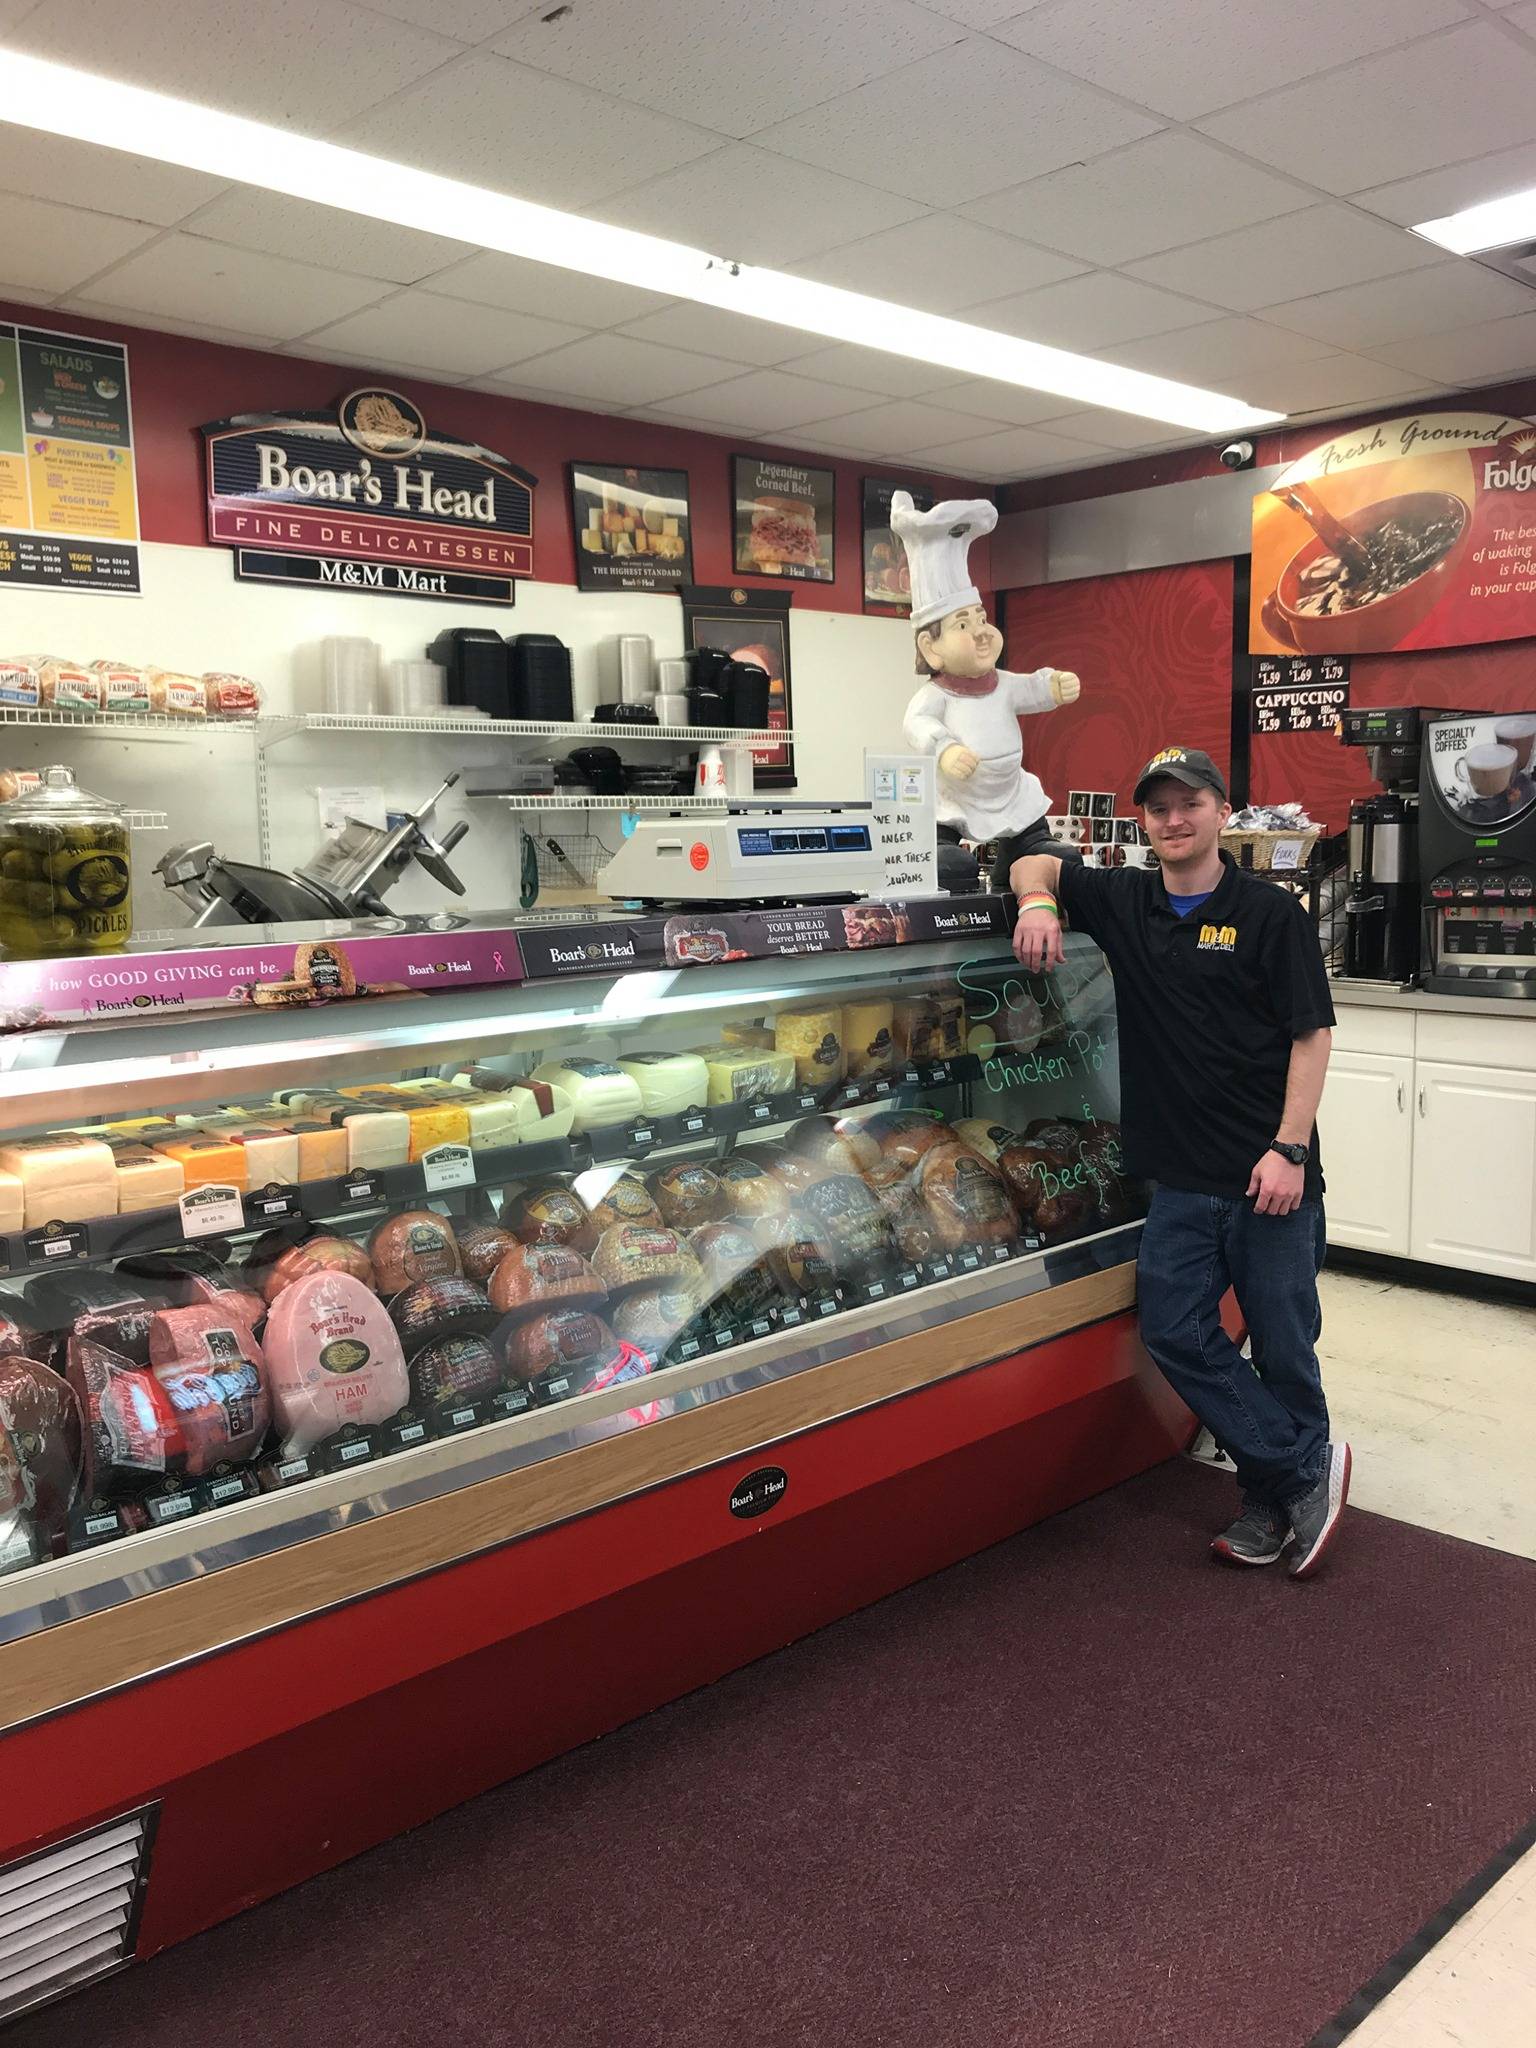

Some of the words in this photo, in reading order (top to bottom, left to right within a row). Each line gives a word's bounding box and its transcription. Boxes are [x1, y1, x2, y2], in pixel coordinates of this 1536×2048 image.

[40, 352, 93, 372] SALADS
[56, 448, 80, 457] PARTY
[82, 451, 104, 461] TRAYS
[1320, 428, 1387, 475] Fresh
[1400, 420, 1508, 455] Ground
[760, 462, 808, 482] Legendary
[256, 443, 382, 506] Boar's
[394, 465, 497, 523] Head
[755, 476, 790, 492] Corned
[791, 482, 815, 497] Beef.
[58, 495, 85, 505] VEGGIE
[87, 498, 109, 507] TRAYS
[236, 517, 301, 538] FINE
[321, 528, 516, 564] DELICATESSEN
[1493, 529, 1515, 542] The
[19, 543, 34, 551] Large
[1472, 548, 1486, 563] of
[1488, 545, 1533, 560] waking
[20, 553, 41, 561] Medium
[68, 553, 93, 562] VEGGIE
[71, 563, 92, 572] TRAYS
[593, 567, 609, 575] THE
[610, 567, 642, 576] HIGHEST
[643, 569, 682, 577] STANDARD
[1500, 564, 1509, 576] is
[319, 560, 385, 586] M&M
[396, 568, 448, 593] Mart
[1470, 584, 1482, 596] in
[1484, 582, 1512, 598] your
[1259, 672, 1280, 685] $1.59
[1289, 669, 1312, 682] $1.69
[1321, 666, 1343, 679] $1.79
[58, 682, 98, 694] FARMHOUSE
[109, 683, 148, 694] FARMHOUSE
[1256, 690, 1344, 707] CAPPUCCINO
[1258, 718, 1280, 731] $1.59
[1289, 716, 1312, 729] $1.69
[1318, 714, 1340, 727] $1.79
[1435, 727, 1475, 741] SPECIALTY
[1435, 739, 1467, 752] COFFEES
[897, 815, 910, 823] NO
[905, 852, 931, 862] THESE
[78, 914, 127, 933] PICKLES
[767, 922, 793, 933] YOUR
[795, 920, 825, 931] BREAD
[935, 915, 958, 928] Boar's
[969, 912, 991, 924] Head
[767, 935, 794, 944] deserves
[795, 930, 830, 941] BETTER
[550, 946, 585, 963] Boar's
[603, 941, 635, 957] Head
[807, 943, 823, 951] Head
[1197, 941, 1215, 949] MART
[408, 965, 434, 975] Boar's
[448, 961, 472, 972] Head
[50, 978, 82, 991] how
[88, 970, 148, 989] GOOD
[154, 964, 223, 983] GIVING
[229, 965, 255, 977] can
[260, 961, 280, 974] be.
[96, 996, 132, 1012] Boar's
[152, 993, 185, 1006] Head
[985, 1053, 1073, 1093] Chicken
[1031, 1140, 1105, 1206] Beef
[418, 1261, 447, 1273] Virginia
[310, 1312, 340, 1335] Boar's
[342, 1312, 366, 1326] Head
[327, 1324, 354, 1338] Brand
[336, 1383, 368, 1401] HAM
[732, 1491, 754, 1509] Boar's
[764, 1478, 784, 1495] Head
